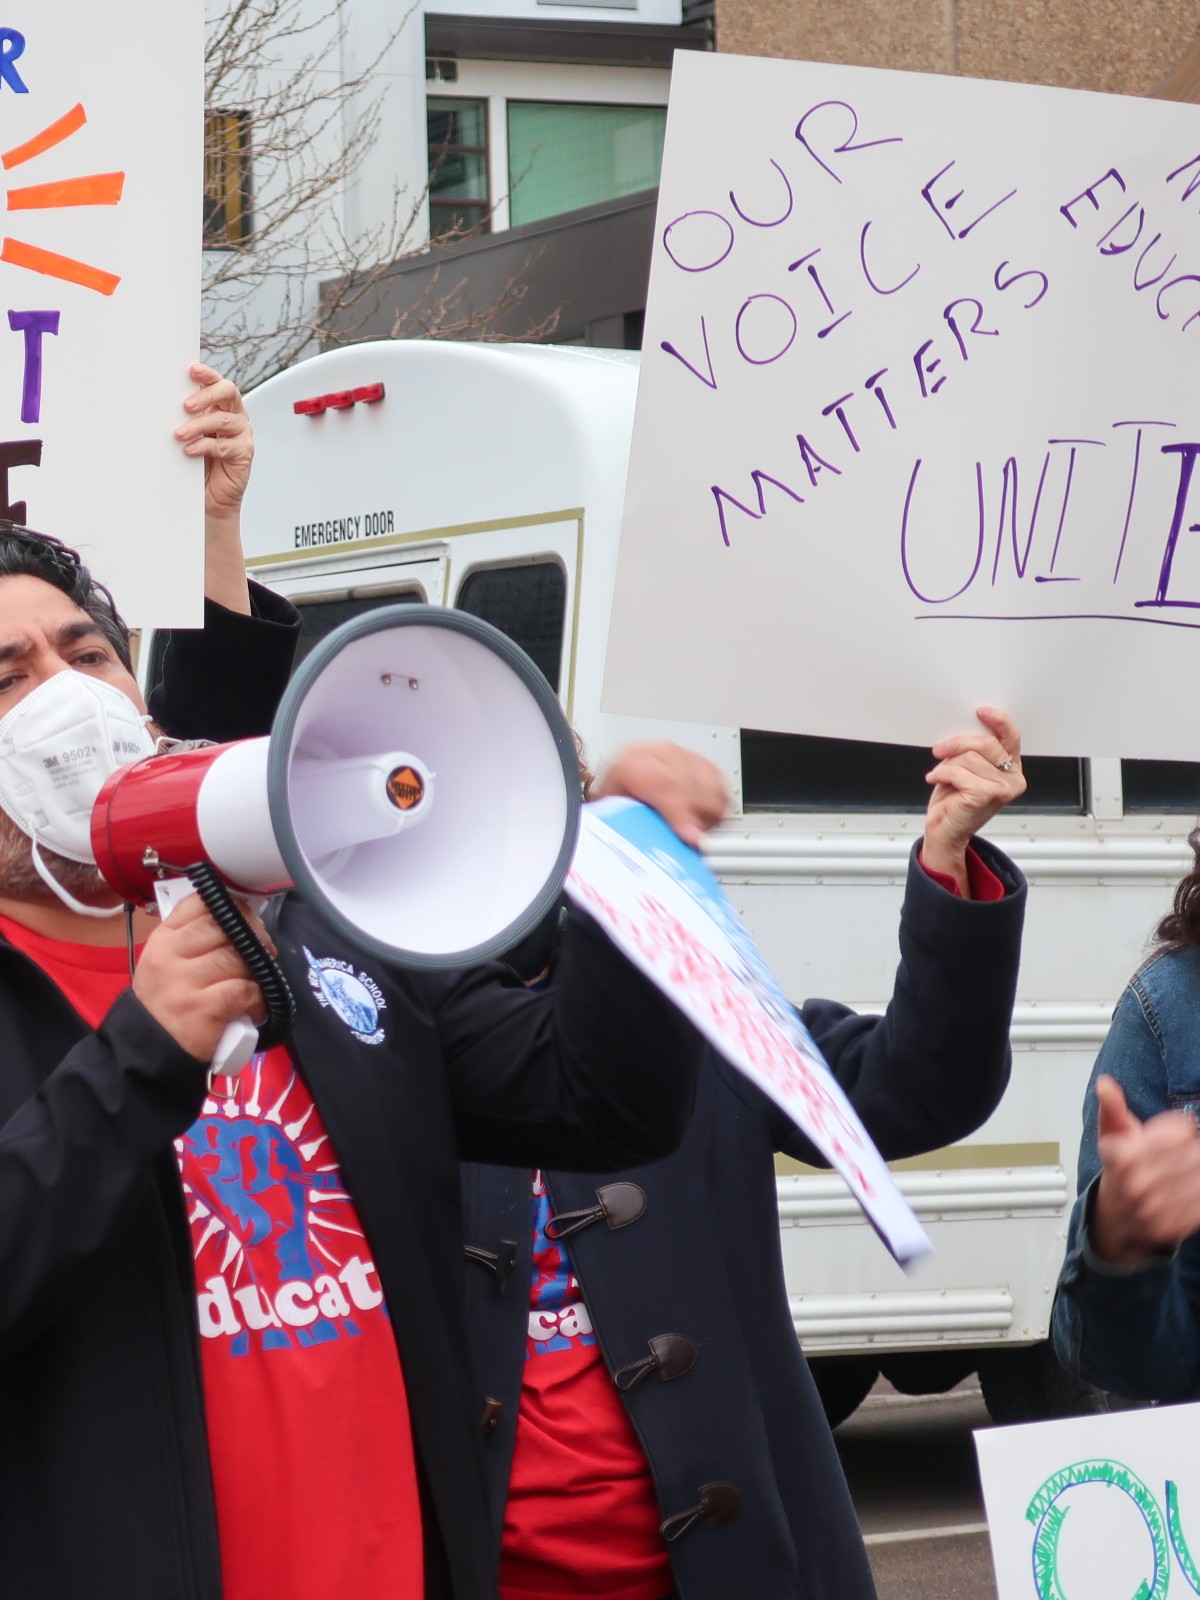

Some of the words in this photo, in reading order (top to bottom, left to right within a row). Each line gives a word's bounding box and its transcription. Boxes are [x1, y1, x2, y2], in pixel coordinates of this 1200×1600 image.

[663, 101, 904, 273] OUR
[660, 160, 1018, 390] VOICE
[709, 261, 1050, 548] MATTERS
[294, 515, 361, 548] EMERGENCY
[365, 510, 395, 537] DOOR
[358, 972, 388, 1011] SCHOOL
